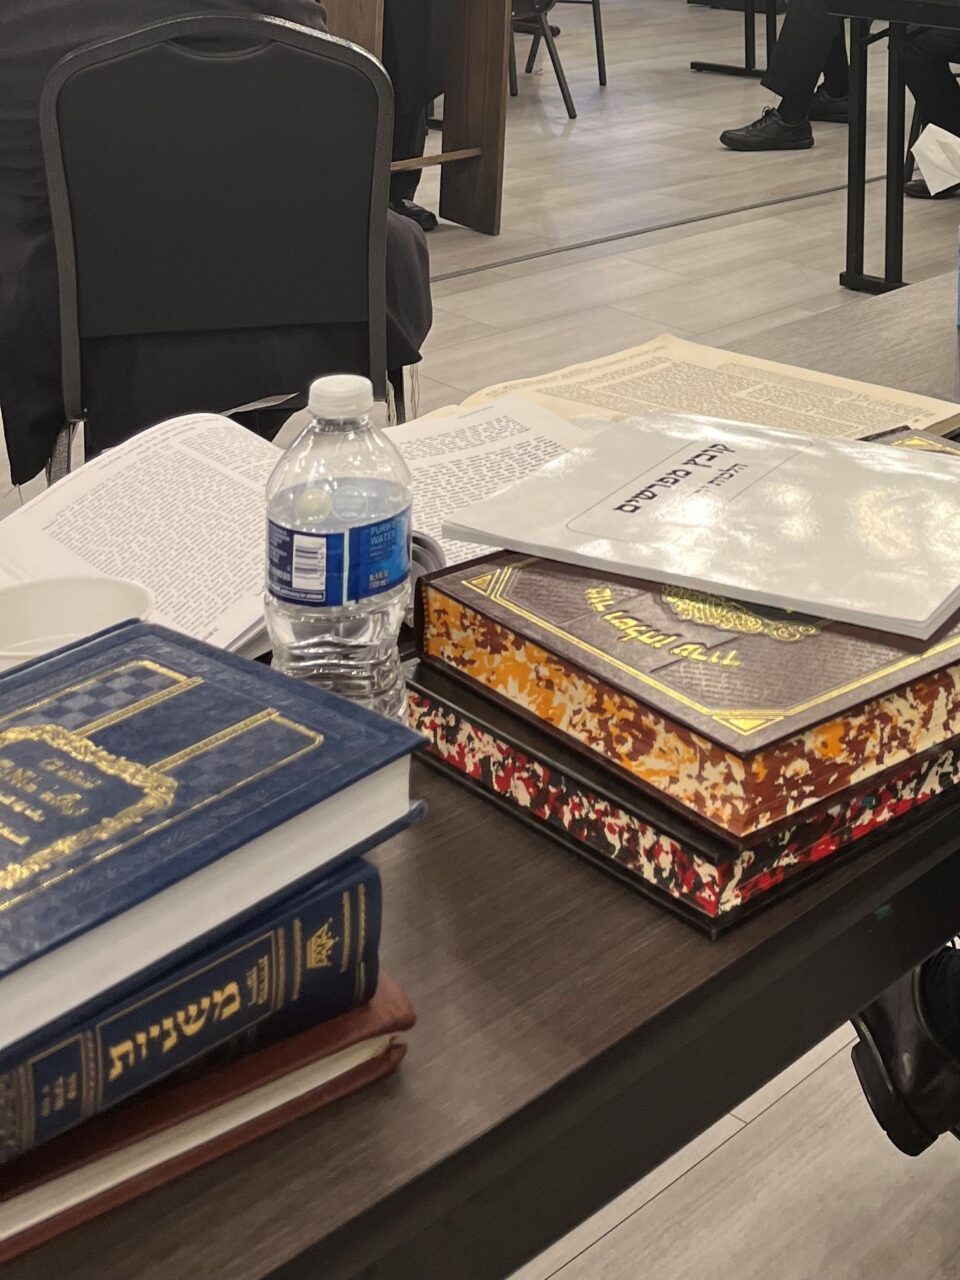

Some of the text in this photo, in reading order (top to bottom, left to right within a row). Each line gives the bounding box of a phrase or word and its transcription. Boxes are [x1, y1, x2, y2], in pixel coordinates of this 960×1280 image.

[613, 443, 736, 514] קובץ מפרשים
[109, 981, 242, 1082] משניות
